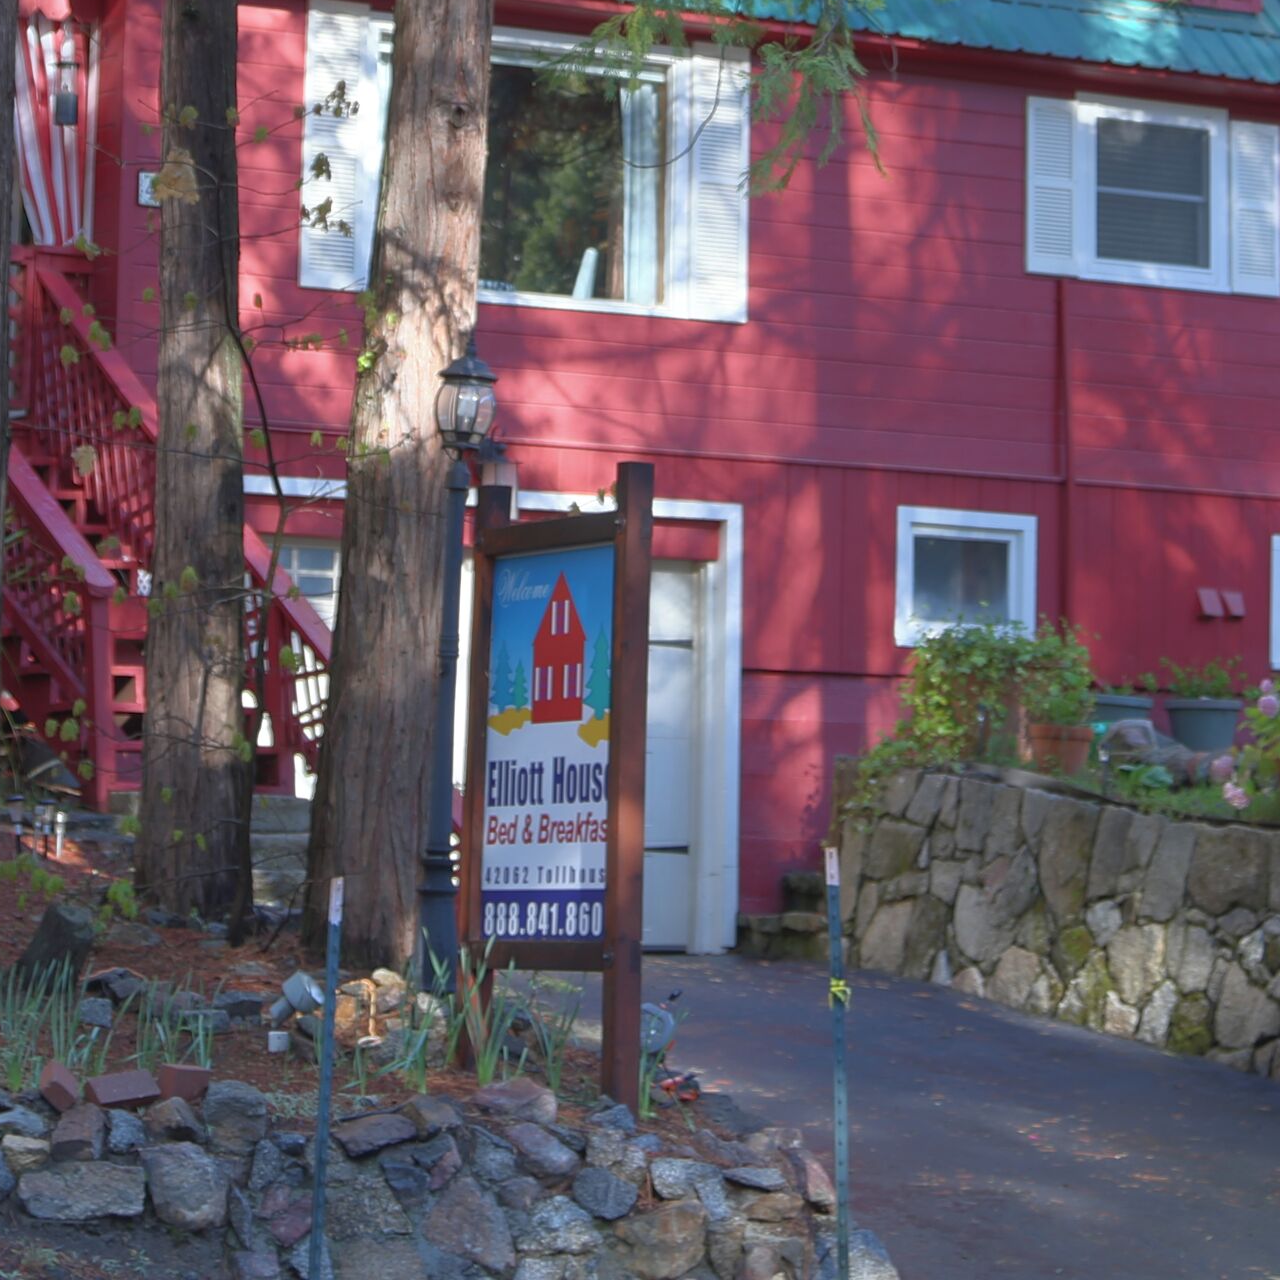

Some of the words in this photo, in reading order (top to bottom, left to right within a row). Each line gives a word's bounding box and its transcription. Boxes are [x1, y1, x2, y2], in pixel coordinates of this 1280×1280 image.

[496, 568, 550, 608] Welcome
[487, 759, 544, 807] Elliott
[487, 814, 519, 845] Bed
[522, 814, 533, 844] &
[485, 866, 529, 885] 42062
[537, 865, 605, 884] Tollhous
[483, 901, 603, 937] 888.841.860
